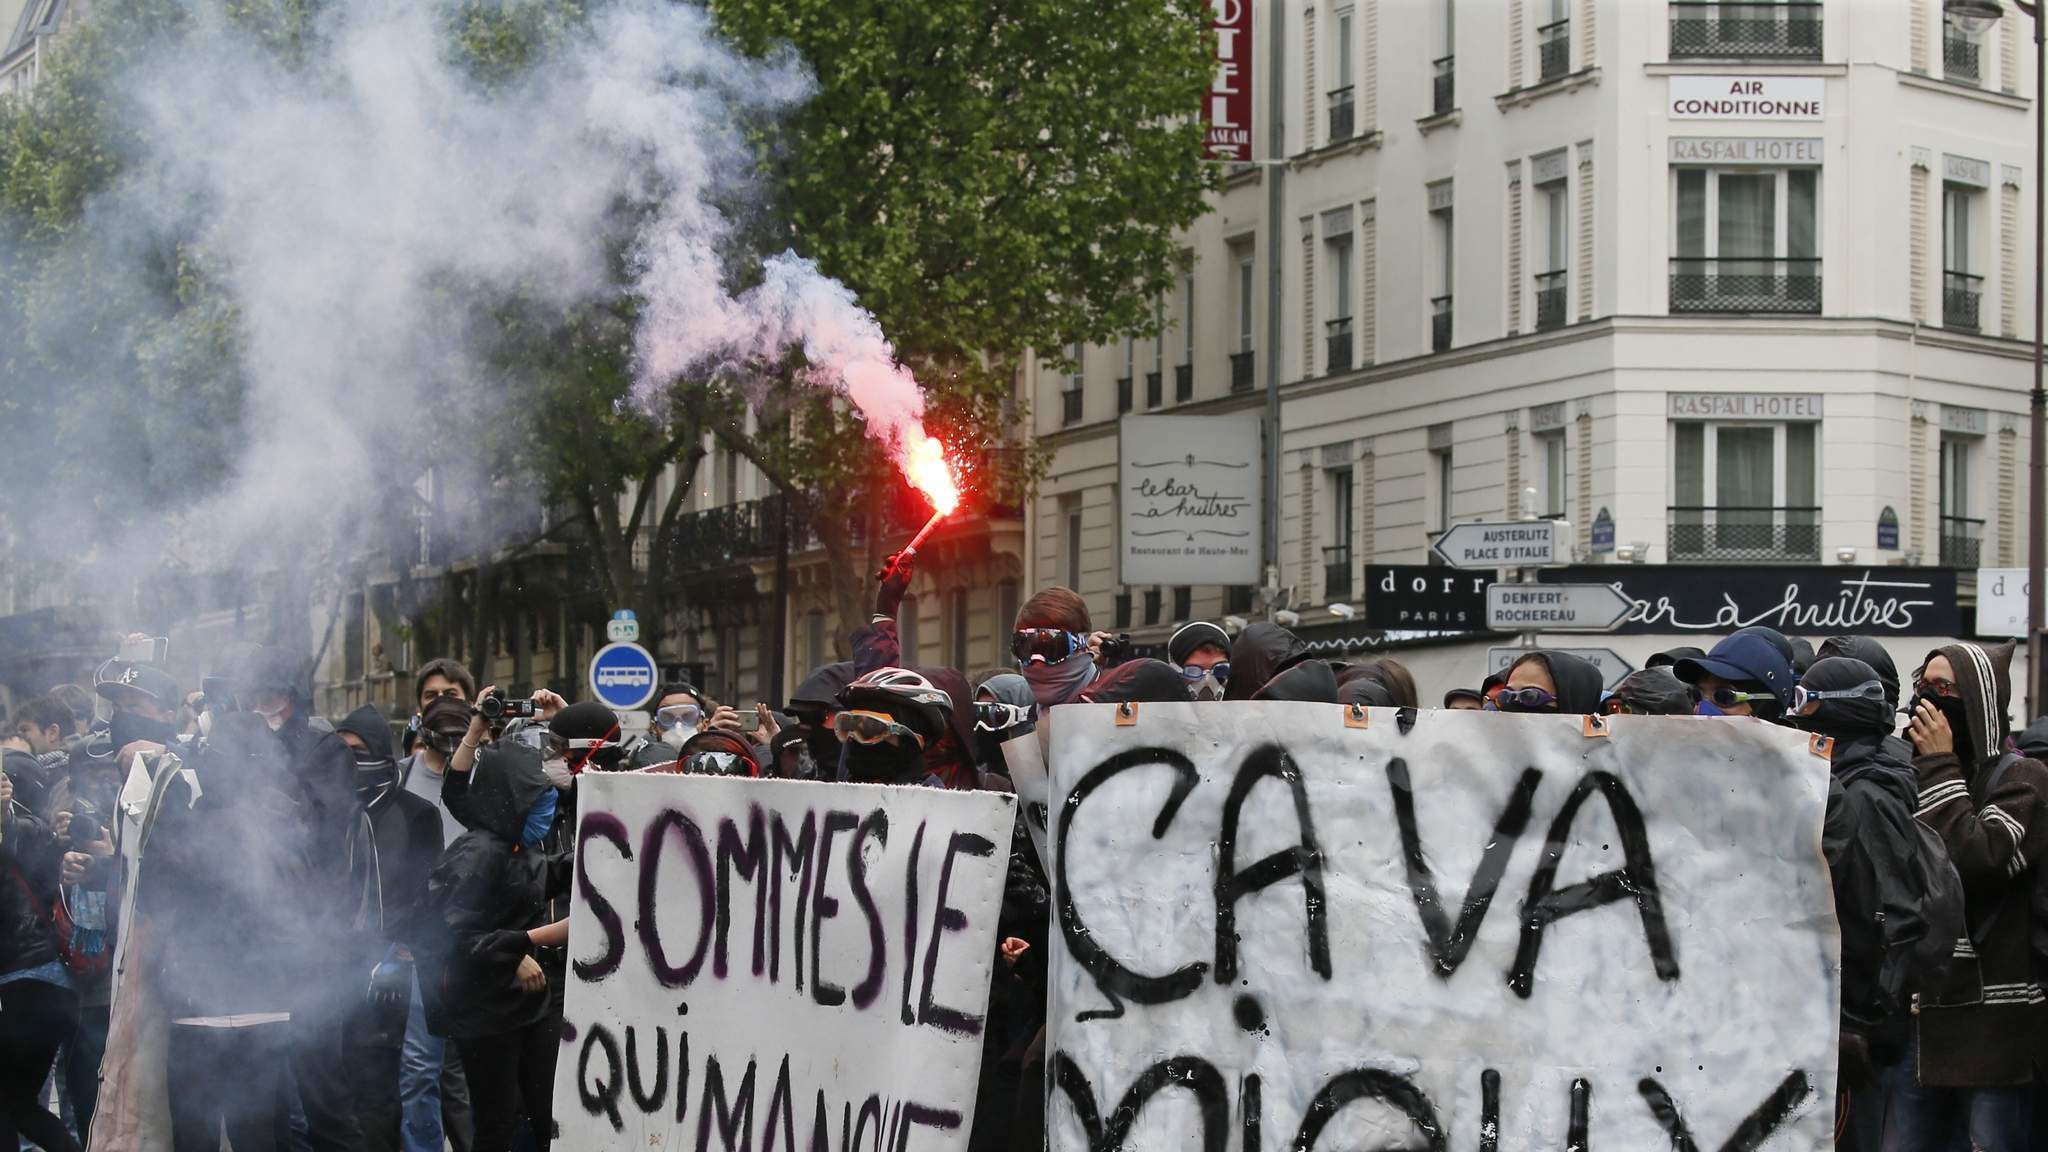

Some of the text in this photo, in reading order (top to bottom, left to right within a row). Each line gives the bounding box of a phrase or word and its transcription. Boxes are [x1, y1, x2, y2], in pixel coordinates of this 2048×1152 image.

[1730, 81, 1764, 95] AIR
[1673, 100, 1820, 115] CONDITIONNE
[1209, 130, 1248, 144] ASPAIL
[1674, 140, 1816, 160] RASPAIL HOTEL
[1673, 395, 1816, 415] RASPAIL HOTEL
[1483, 529, 1549, 542] AUSTERLITZ
[1183, 547, 1196, 555] de
[1464, 546, 1549, 560] PLACE D'ITALIE
[1400, 611, 1466, 622] PARIS
[1495, 609, 1575, 622] ROCHEREAU
[1715, 592, 1748, 627] à
[1385, 756, 1679, 998] VA
[573, 803, 888, 1011] SOMMES
